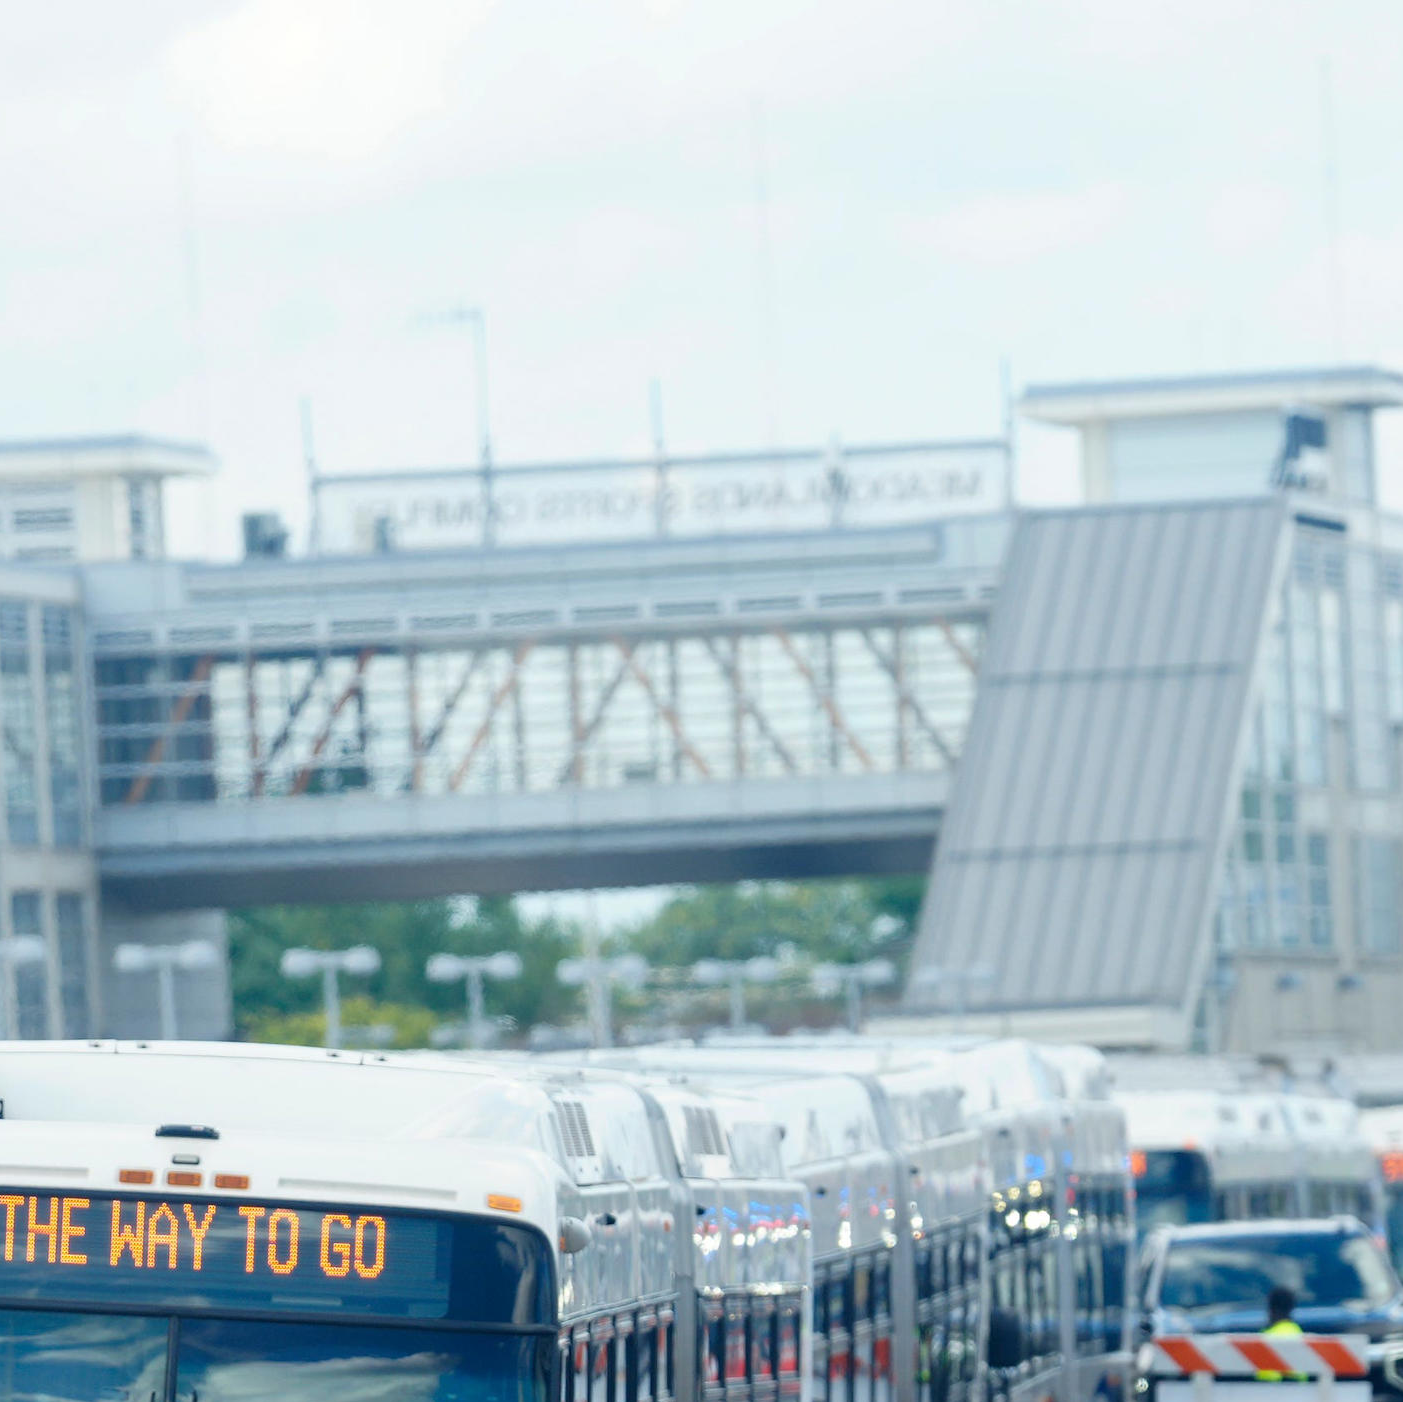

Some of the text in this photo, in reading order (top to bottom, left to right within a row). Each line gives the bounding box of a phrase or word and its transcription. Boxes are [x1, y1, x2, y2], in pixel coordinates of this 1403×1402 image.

[110, 1199, 217, 1271] WAY
[238, 1205, 299, 1275] TO
[319, 1214, 386, 1279] GO
